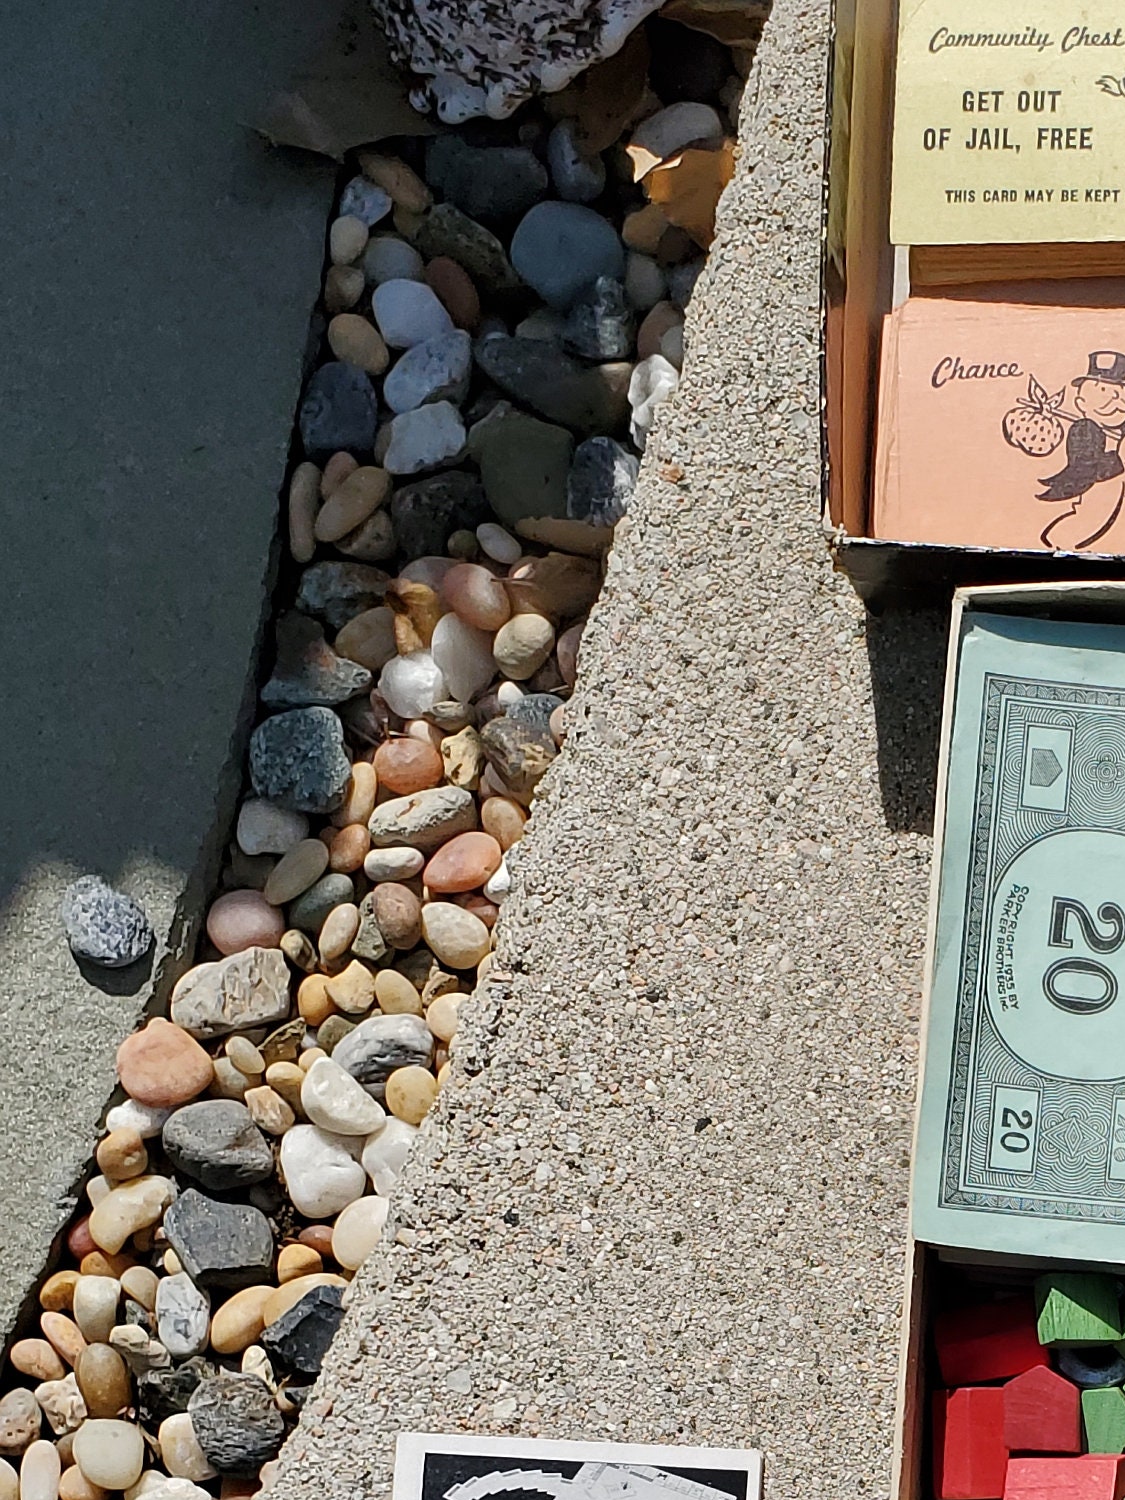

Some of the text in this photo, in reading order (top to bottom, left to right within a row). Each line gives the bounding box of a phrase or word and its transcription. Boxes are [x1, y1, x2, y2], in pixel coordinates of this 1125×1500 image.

[928, 26, 1125, 53] Community Chest
[962, 90, 1061, 113] GET OUT
[923, 128, 1093, 154] OF JAIL, FREE
[945, 189, 976, 203] THIS
[982, 189, 1018, 203] CARD
[1024, 189, 1054, 203] MAY
[1061, 189, 1079, 203] BE
[1085, 189, 1120, 203] KEPT
[931, 357, 1024, 388] Chance
[999, 883, 1021, 934] PARKER
[1004, 885, 1030, 1010] COPYRIGHT 1935 BY
[995, 936, 1006, 995] BROTHERS
[999, 1107, 1033, 1155] 20
